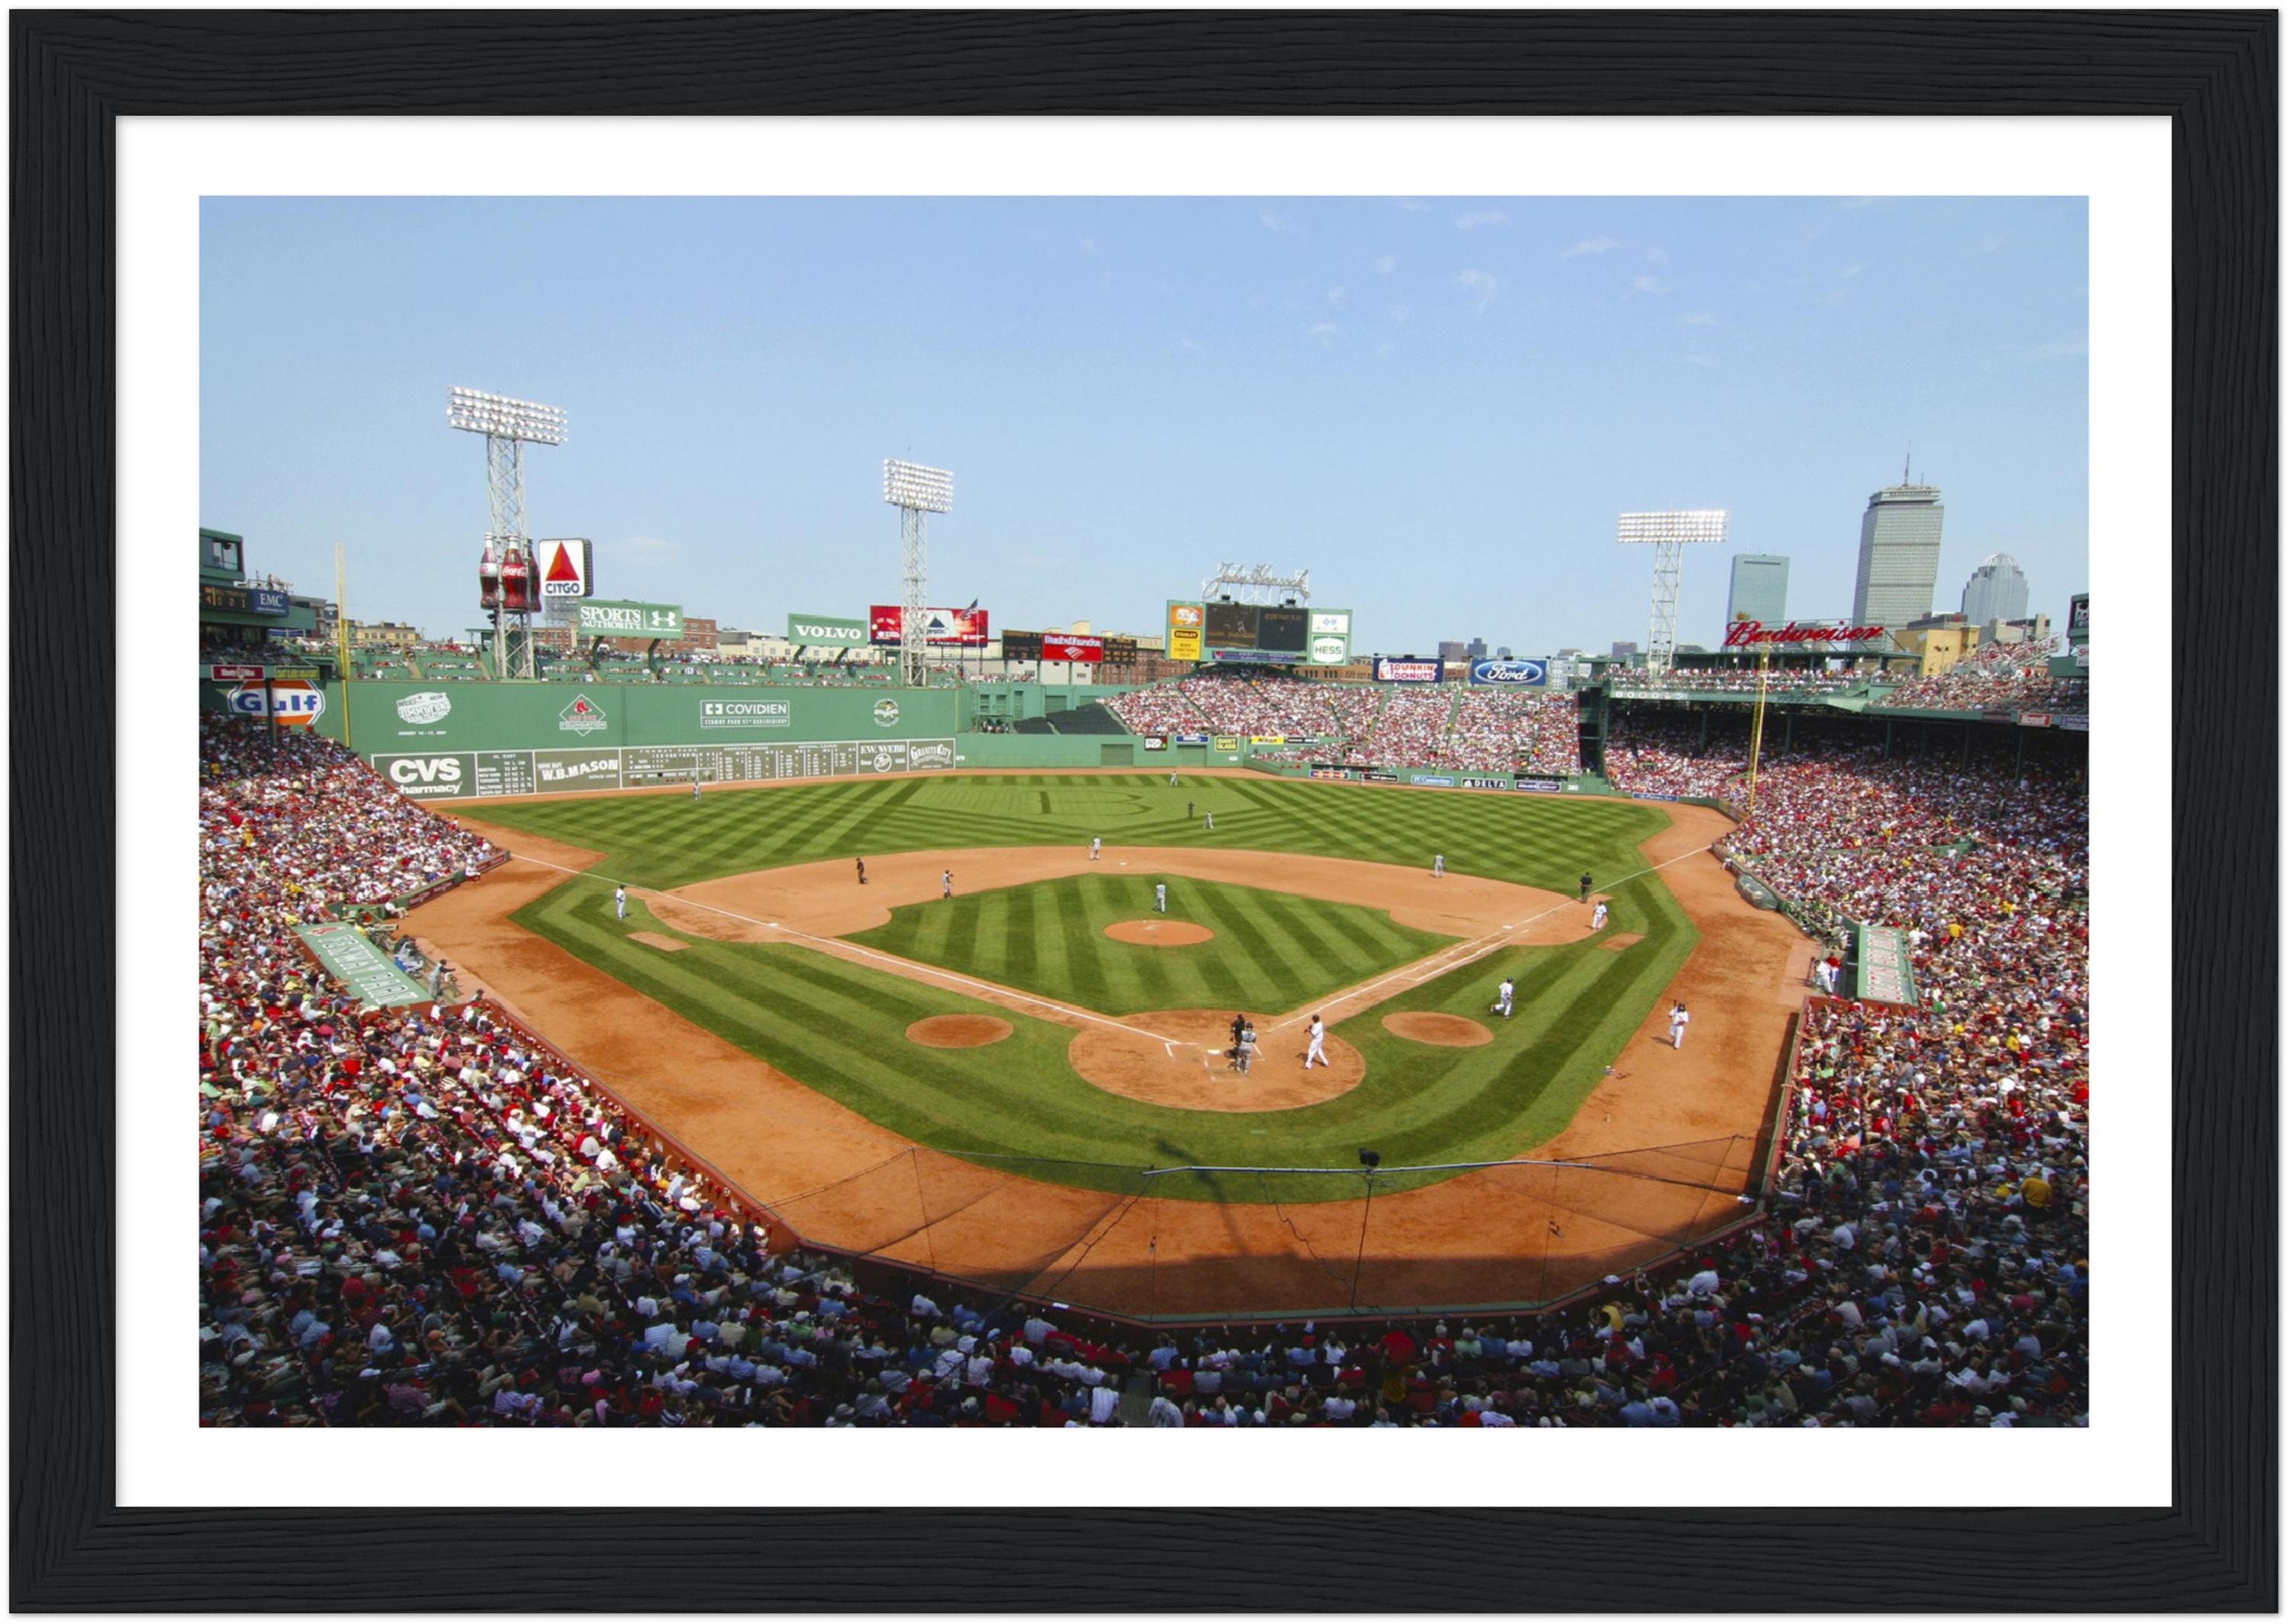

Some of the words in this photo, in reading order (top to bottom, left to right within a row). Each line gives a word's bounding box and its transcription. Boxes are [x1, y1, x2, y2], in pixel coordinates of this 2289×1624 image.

[546, 583, 580, 593] CITGO
[580, 606, 642, 622] SPORTS
[581, 620, 642, 630] AUTHORITY
[795, 625, 861, 639] VOLVO
[1725, 620, 1884, 647] Budweiser
[1315, 645, 1342, 654] HESS
[1393, 672, 1436, 680] DONUTS
[1487, 663, 1532, 681] Ford
[237, 693, 317, 711] Gulf
[726, 704, 787, 714] COVIDIEN
[390, 757, 462, 783] CVS
[399, 783, 462, 794] harmacy
[317, 934, 386, 975] FENWAY
[355, 972, 419, 1005] PARK
